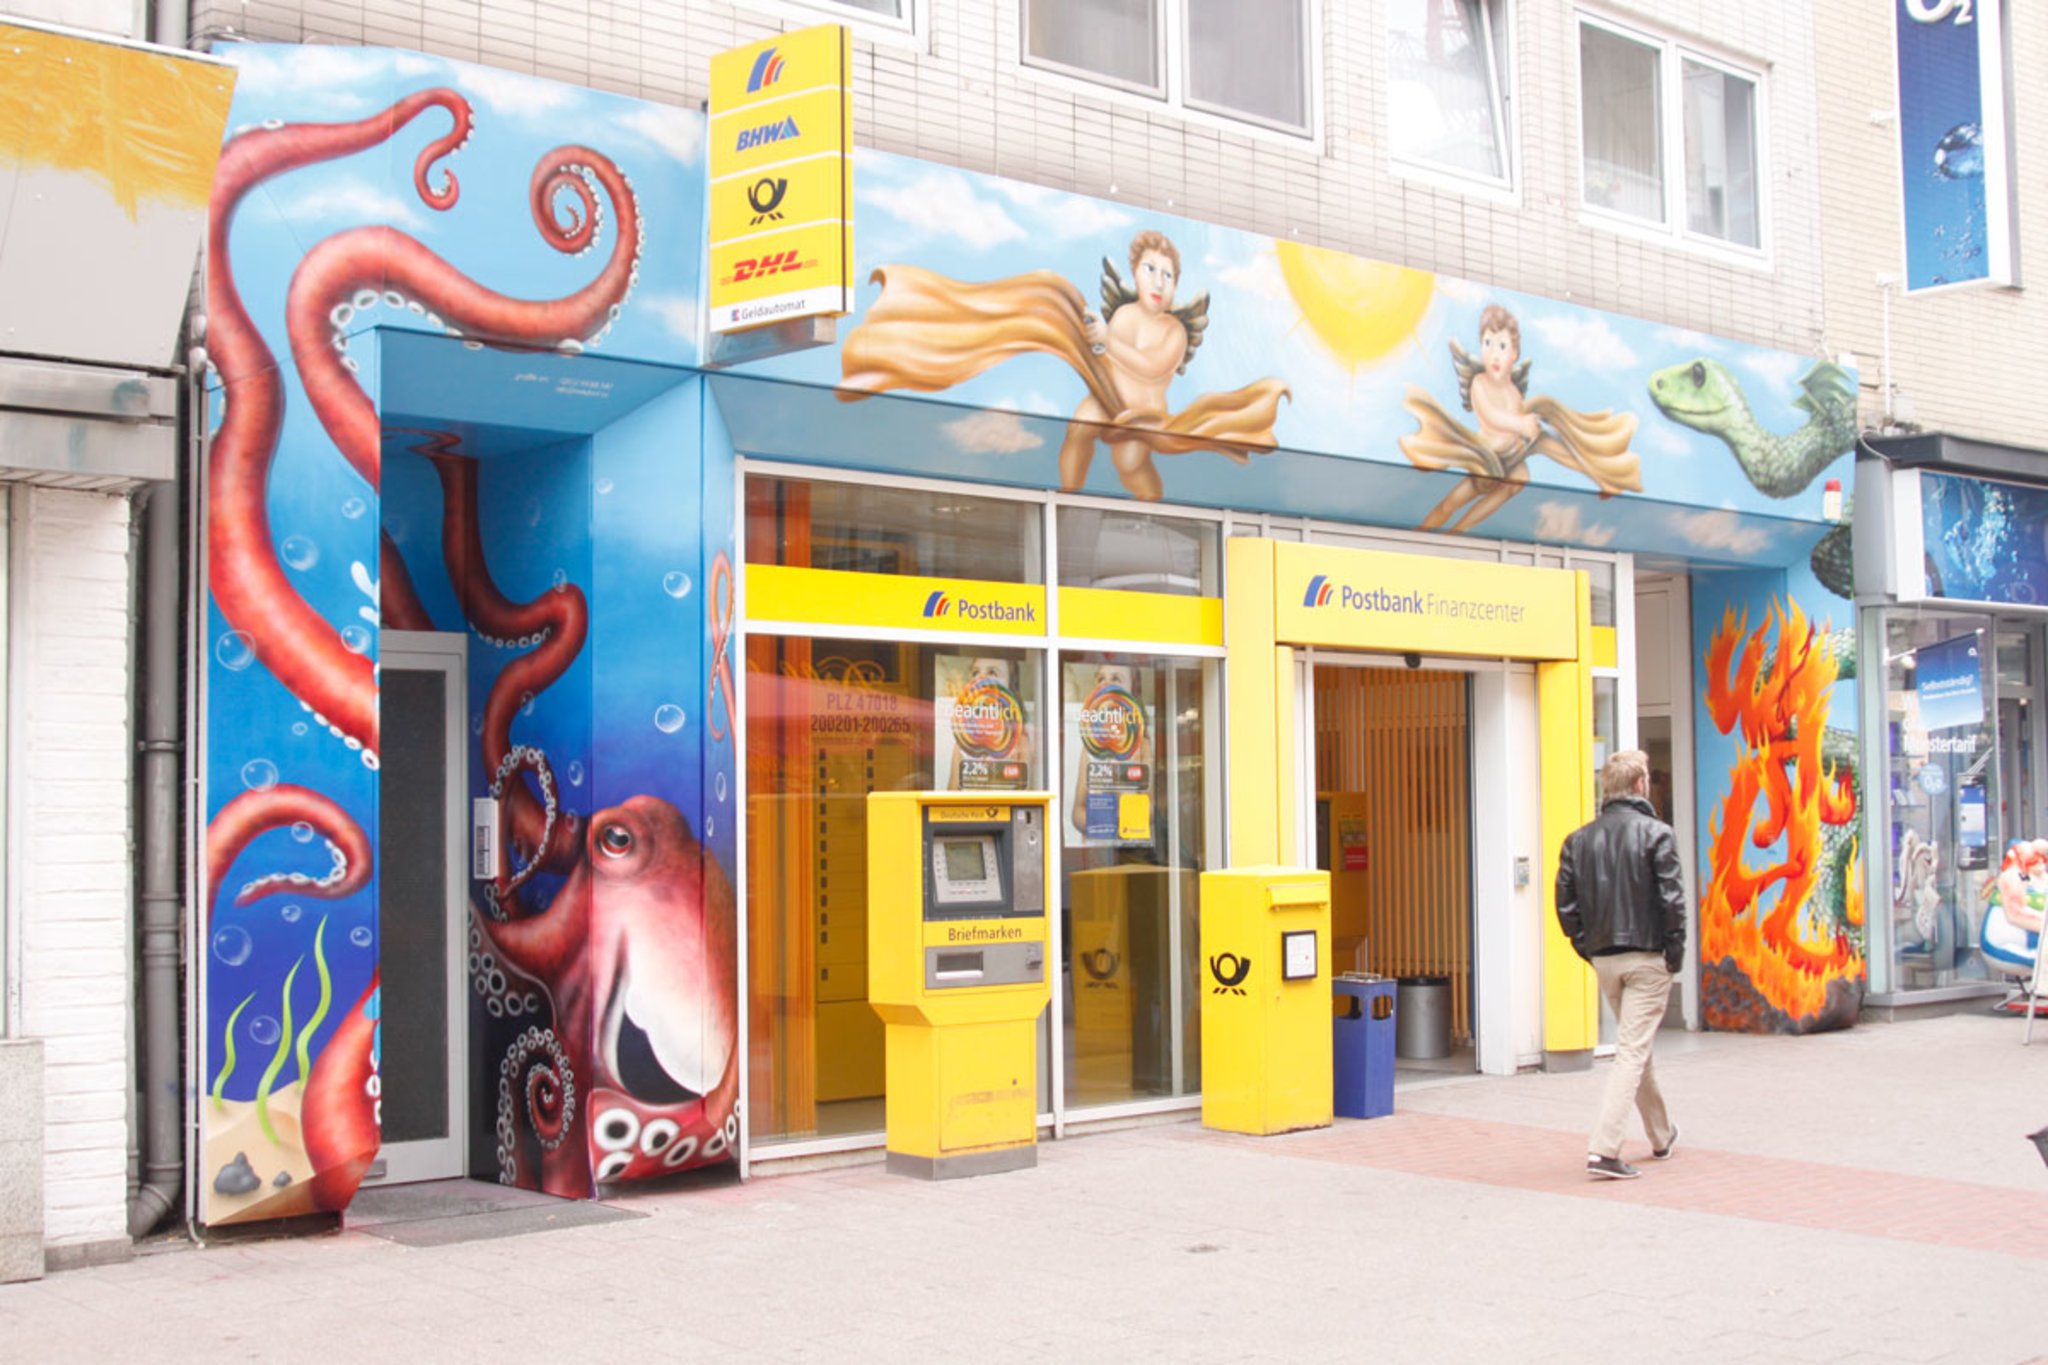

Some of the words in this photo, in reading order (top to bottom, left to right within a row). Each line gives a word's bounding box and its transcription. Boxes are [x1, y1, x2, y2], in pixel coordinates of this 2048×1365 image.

[733, 250, 803, 282] DHL
[741, 300, 805, 319] Geldautomat
[958, 598, 1036, 622] Postbank
[1342, 585, 1424, 615] Postbank
[1427, 593, 1526, 623] Finanzcenter
[826, 693, 852, 711] PLZ
[1903, 734, 1977, 753] Mstertarif
[948, 925, 1022, 941] Briefmarken
